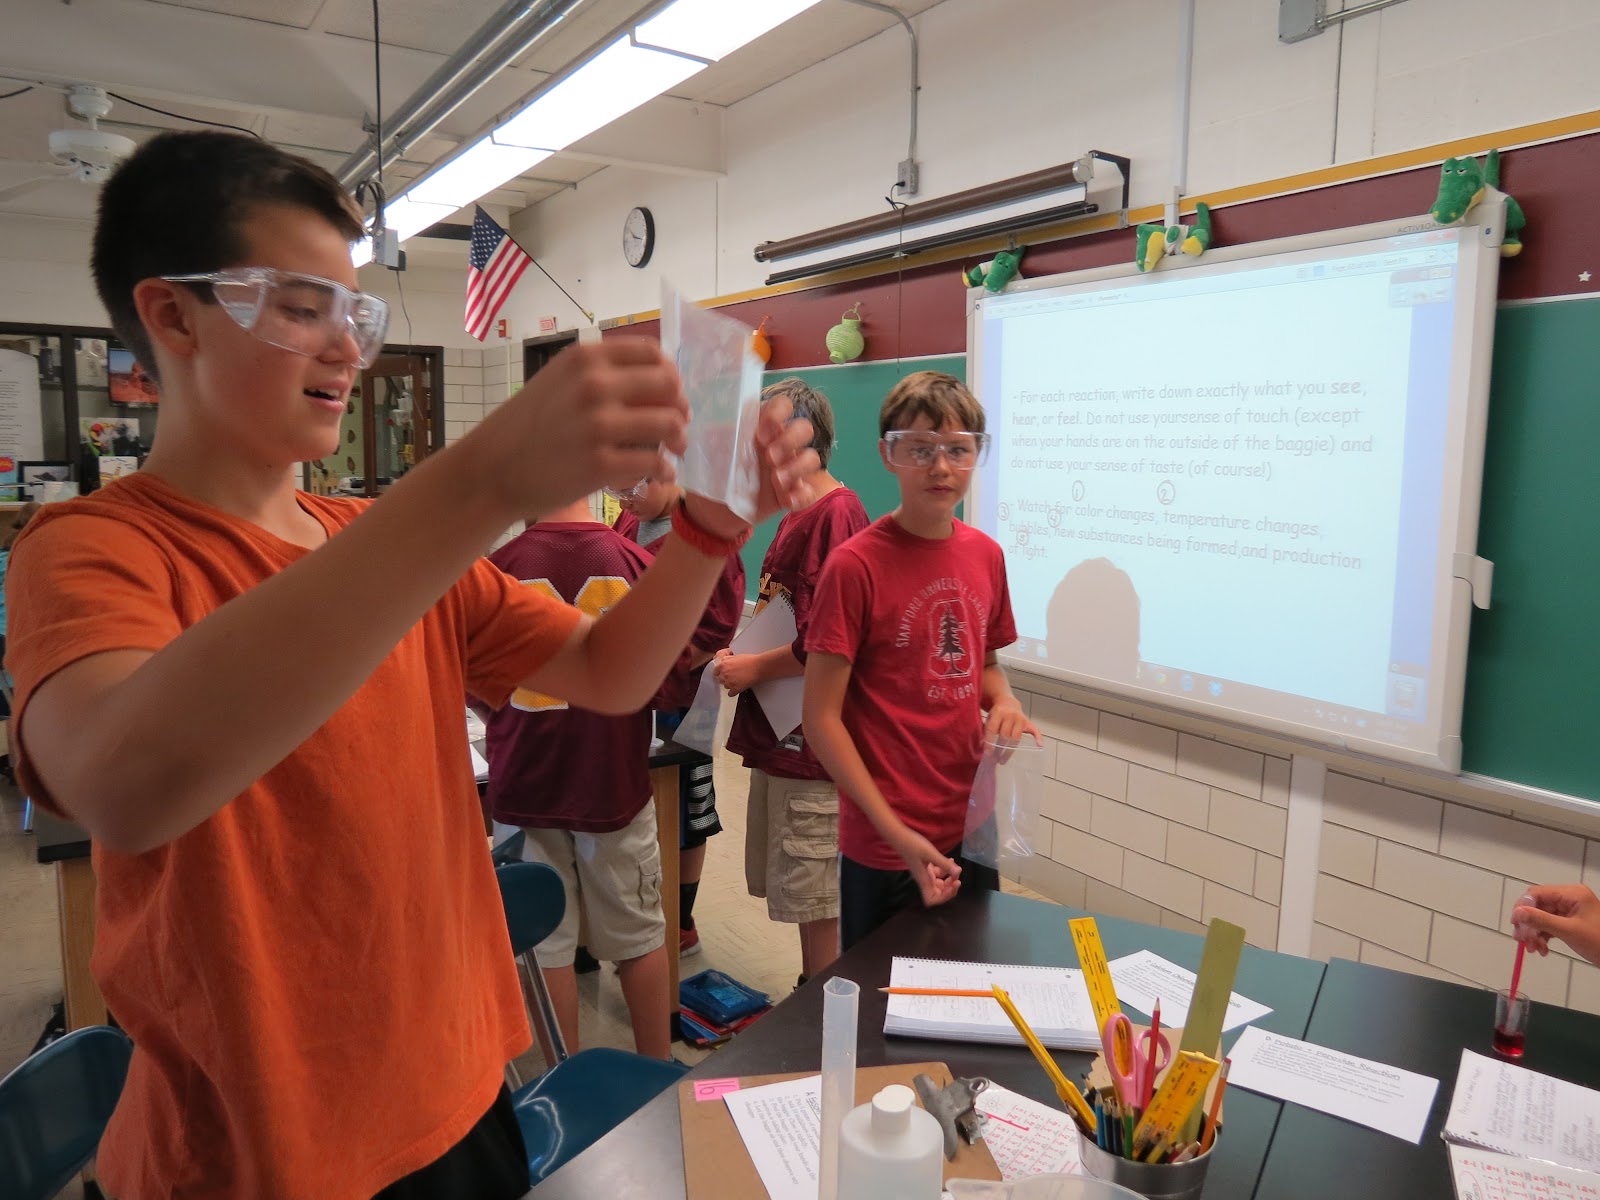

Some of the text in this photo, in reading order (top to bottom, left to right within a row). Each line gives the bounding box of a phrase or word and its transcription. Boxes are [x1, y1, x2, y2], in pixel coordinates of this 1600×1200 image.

[1020, 391, 1038, 404] For
[1041, 389, 1065, 402] each
[1068, 388, 1119, 403] reaction,
[1122, 386, 1155, 400] write
[1159, 384, 1191, 399] down
[1196, 382, 1248, 401] exactly
[1254, 380, 1292, 396] what
[1297, 383, 1325, 400] you
[1330, 381, 1367, 397] see,
[1012, 412, 1039, 427] hear,
[1042, 415, 1054, 424] or
[1057, 411, 1082, 425] feel.
[1086, 412, 1102, 425] Do
[1105, 412, 1124, 424] not
[1128, 413, 1149, 424] use
[1224, 408, 1241, 424] of
[1246, 408, 1289, 423] touch
[1294, 407, 1364, 428] (except
[1012, 434, 1374, 456] when your hands are on the outside of the baggie) and
[1011, 457, 1272, 482] do not use your sense of taste (of course!)
[1018, 499, 1050, 513] Watch
[1055, 503, 1072, 515] for
[1075, 504, 1103, 517] color
[1106, 506, 1158, 525] changes,
[1164, 510, 1250, 530] temperature
[1009, 520, 1051, 538] bubbles,
[1055, 527, 1075, 537] new
[1078, 527, 1143, 545] substances
[1147, 532, 1181, 554] being
[1272, 548, 1362, 569] production
[1023, 544, 1047, 560] light.
